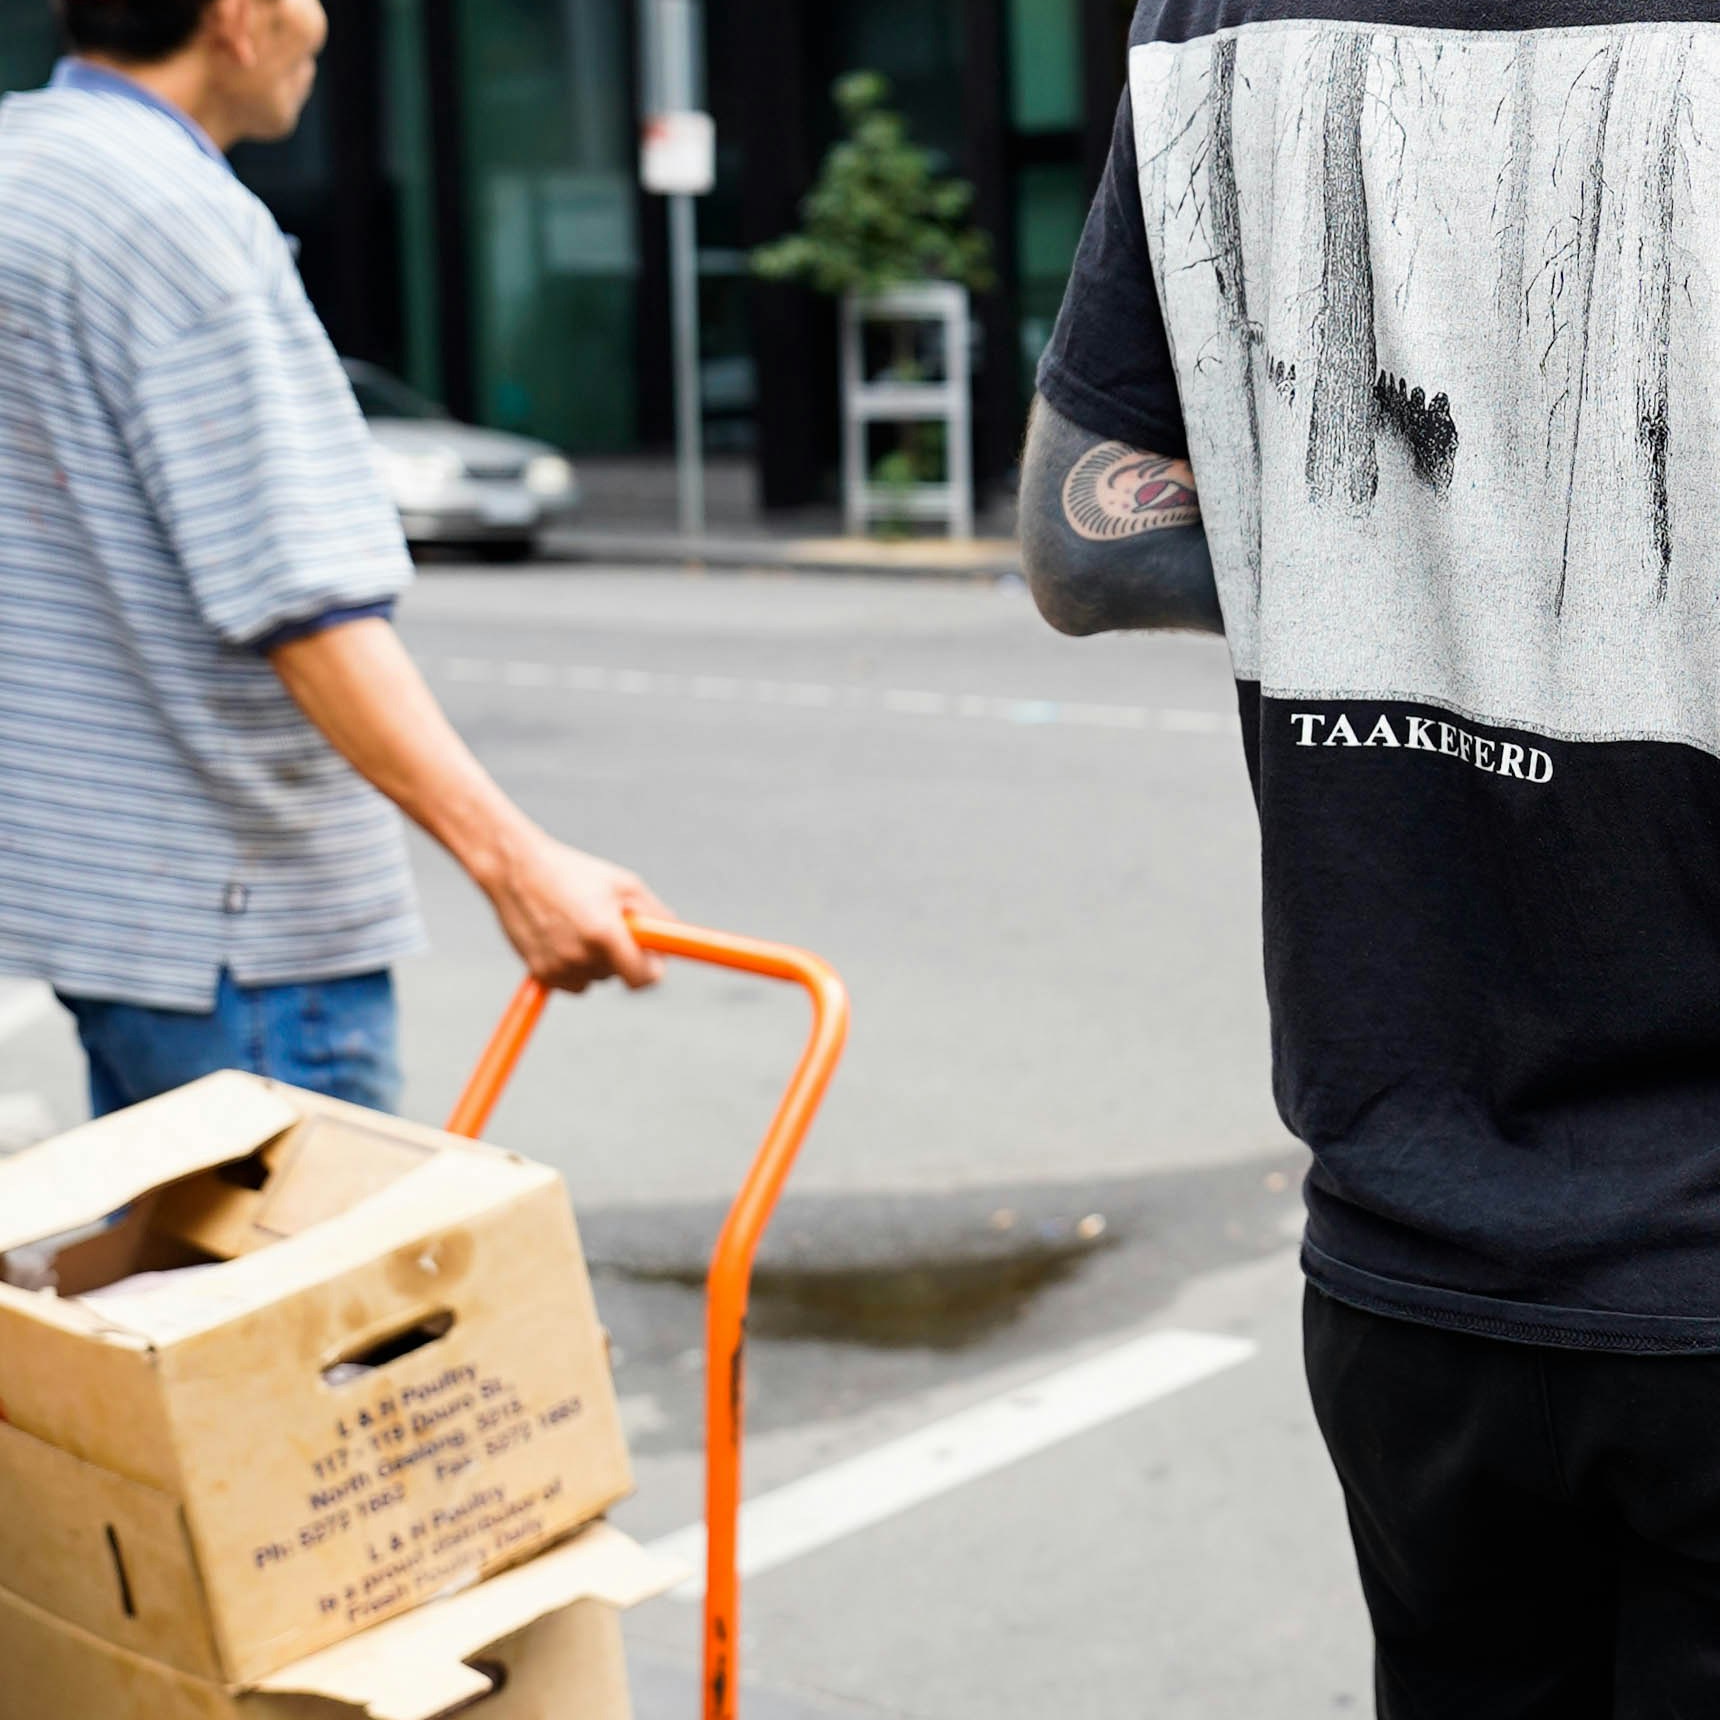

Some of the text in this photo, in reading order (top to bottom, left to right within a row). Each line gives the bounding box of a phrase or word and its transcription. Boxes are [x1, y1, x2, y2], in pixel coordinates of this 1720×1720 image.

[1290, 713, 1554, 784] TAAKEFERD
[401, 1364, 477, 1407] Poultry
[312, 1446, 349, 1479] 117
[309, 1471, 370, 1510] North
[431, 1486, 505, 1529] Poultry
